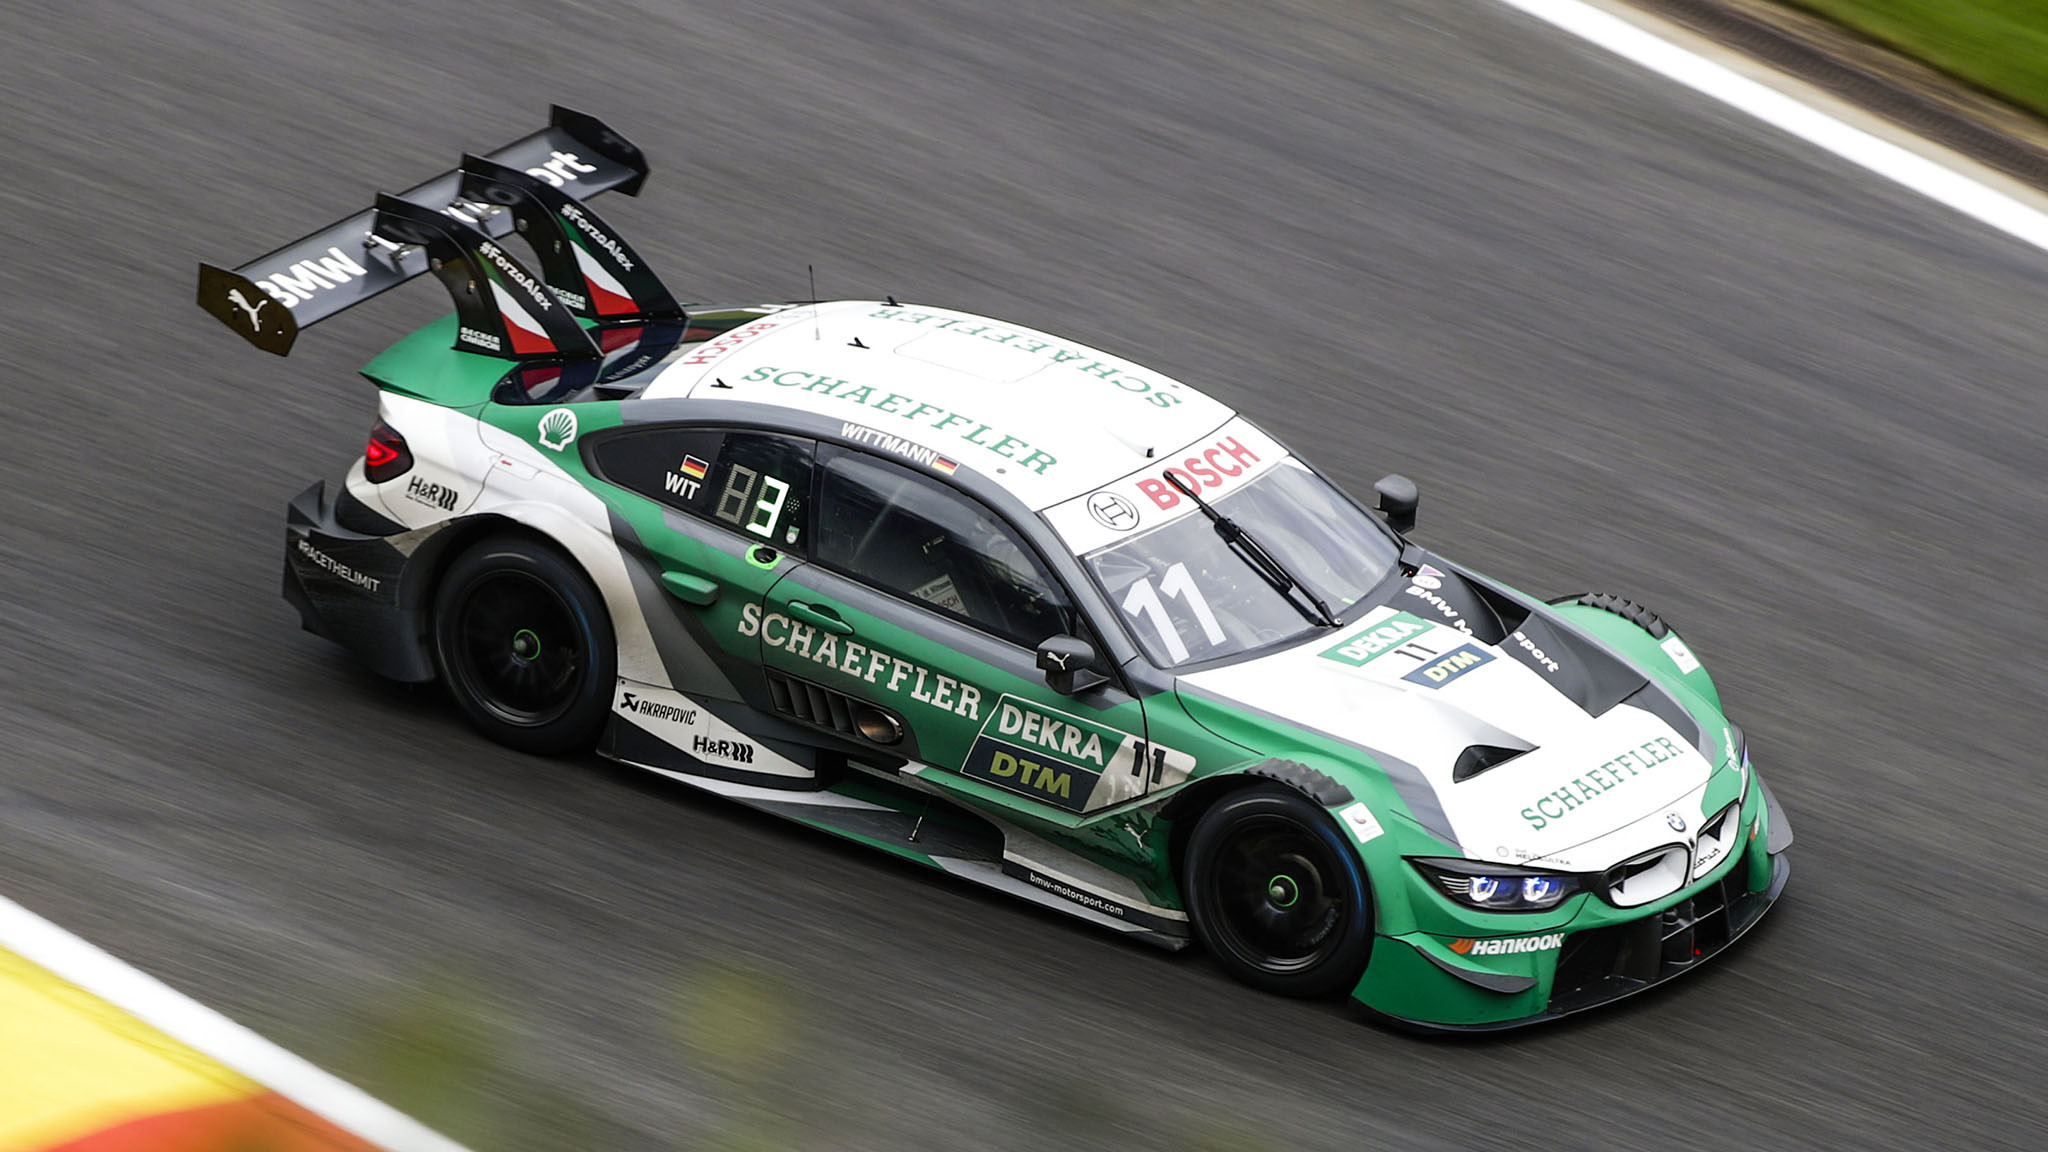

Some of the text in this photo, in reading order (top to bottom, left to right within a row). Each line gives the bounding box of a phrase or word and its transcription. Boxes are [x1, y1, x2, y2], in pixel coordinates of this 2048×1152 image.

[561, 203, 634, 272] #ForzaAlex
[479, 241, 552, 311] #ForzaAlex
[683, 323, 777, 365] BOSCH
[868, 308, 1183, 409] SCHAEFFLER
[741, 366, 1058, 475] SCHAEFFLER
[840, 422, 937, 466] WITTMANN
[664, 471, 701, 500] WIT
[1135, 436, 1261, 511] BOSCH
[1121, 562, 1227, 665] 11
[1405, 585, 1458, 618] BMW
[737, 602, 983, 721] SCHAEFFLER
[1336, 620, 1424, 662] DEKRA
[1394, 643, 1439, 662] 11
[1423, 651, 1482, 683] DTM
[998, 703, 1104, 766] DEKRA
[989, 750, 1072, 799] DTM
[1131, 740, 1167, 785] 11
[1520, 736, 1684, 831] SCHAEFFLER
[1030, 872, 1124, 916] bmw-motorsport.com
